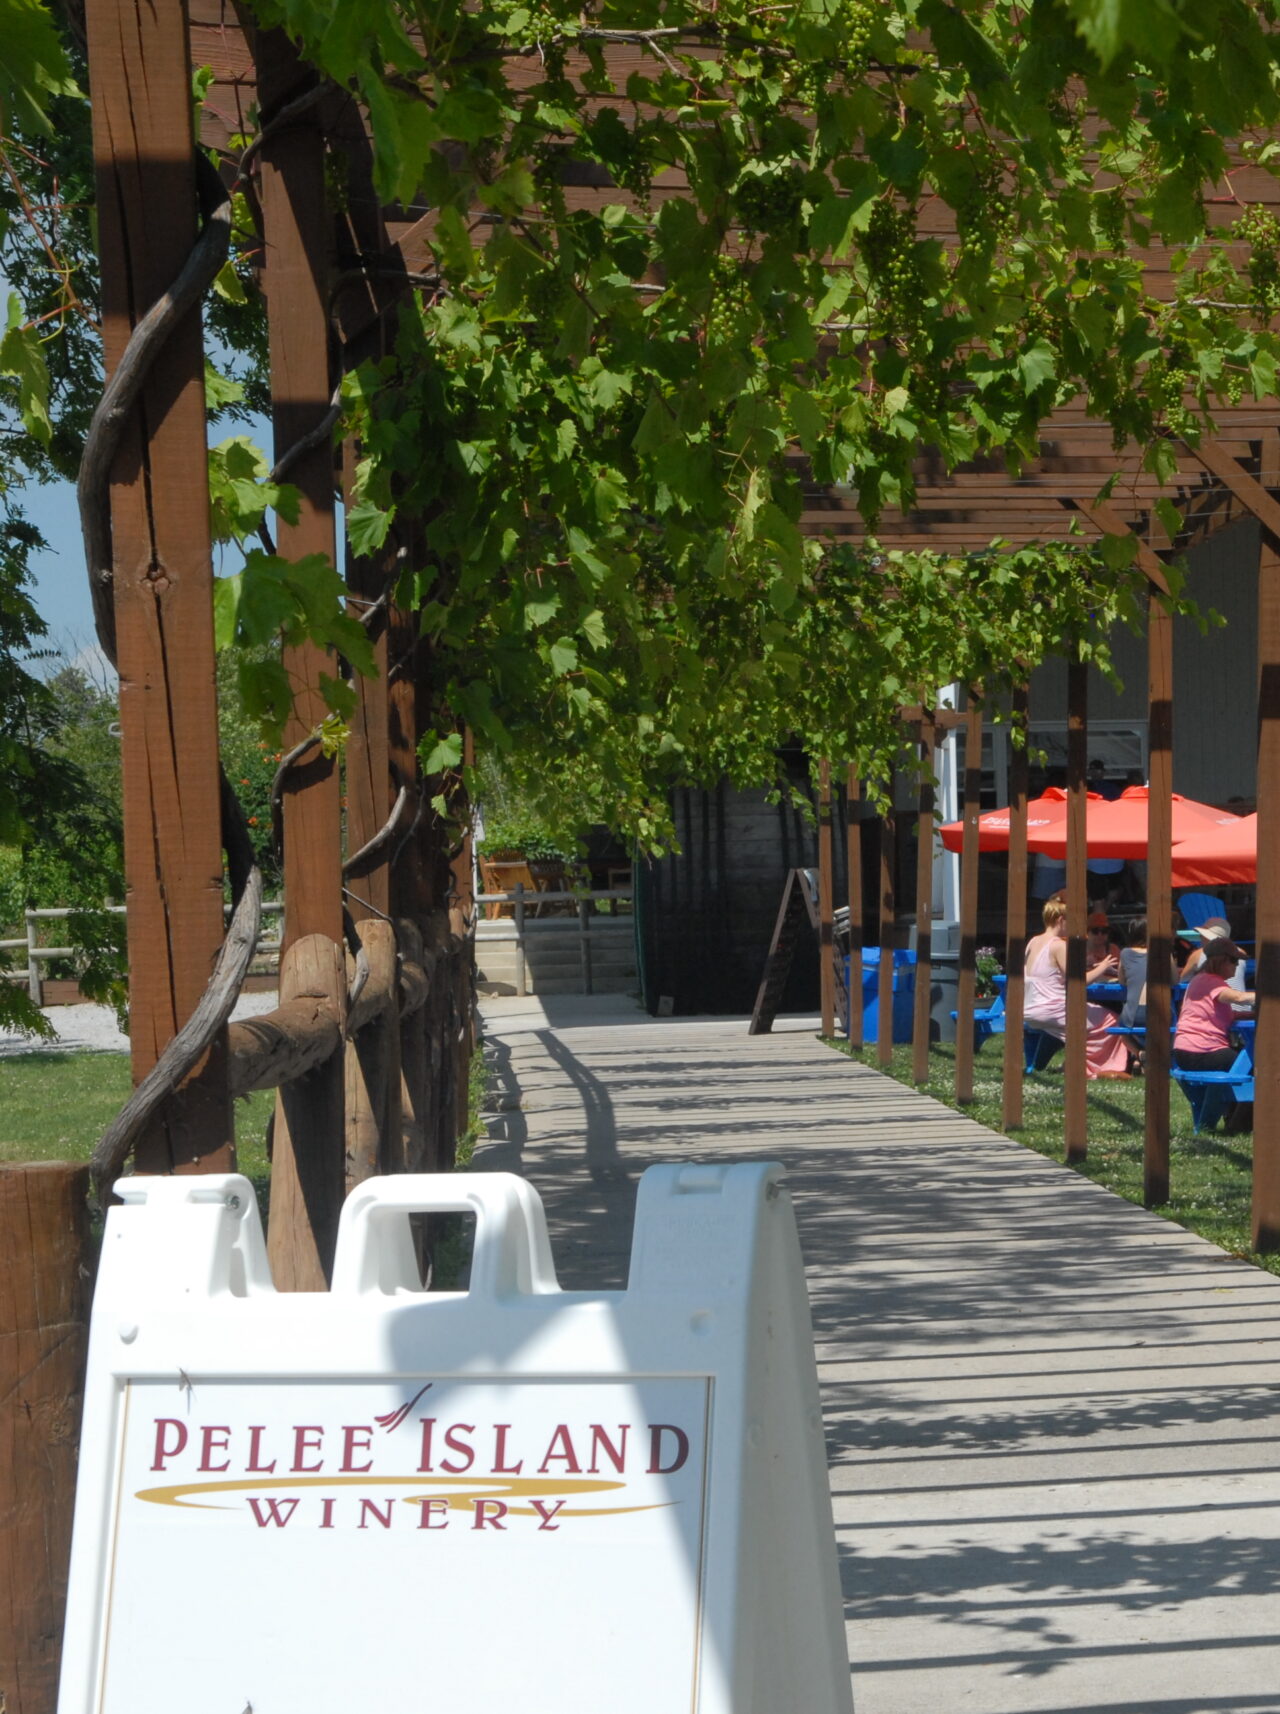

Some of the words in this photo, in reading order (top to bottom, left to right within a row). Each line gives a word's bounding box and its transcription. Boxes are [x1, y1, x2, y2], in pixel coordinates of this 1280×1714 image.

[149, 1417, 375, 1474] PELEE
[415, 1417, 691, 1476] ISLAND
[245, 1497, 568, 1532] WINERY
